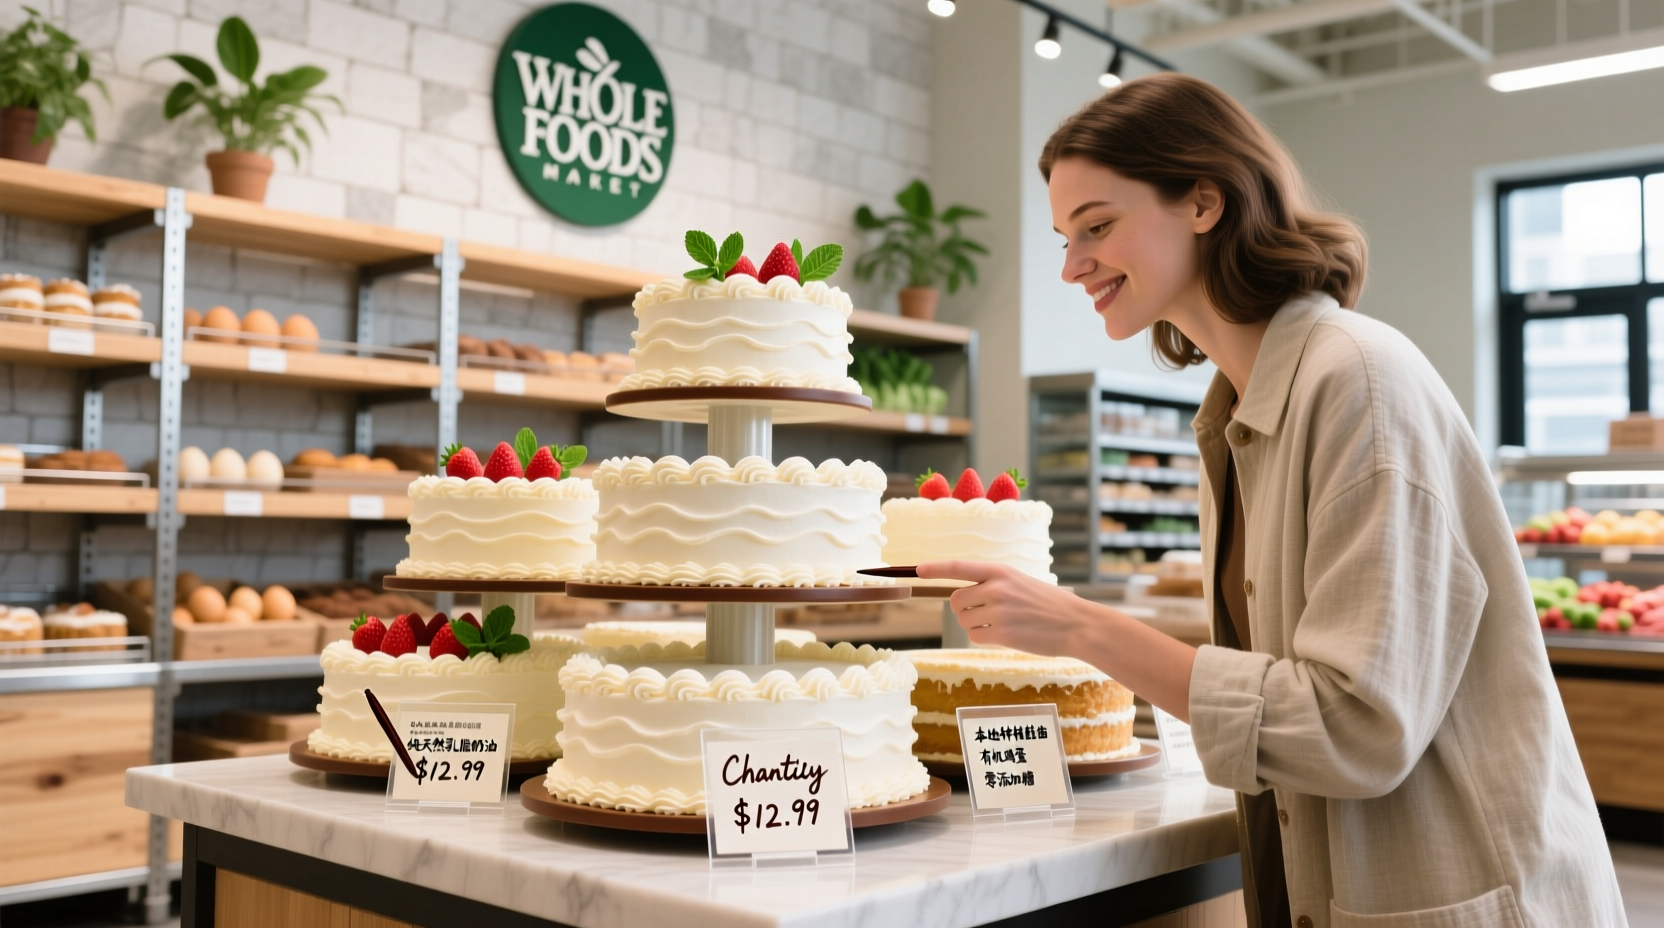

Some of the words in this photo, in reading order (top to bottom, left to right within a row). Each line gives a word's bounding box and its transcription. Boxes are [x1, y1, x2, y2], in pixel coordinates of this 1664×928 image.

[512, 50, 668, 139] WHOLE
[519, 106, 663, 184] FOODS
[415, 756, 485, 785] $12.99
[734, 797, 820, 834] $12.99
